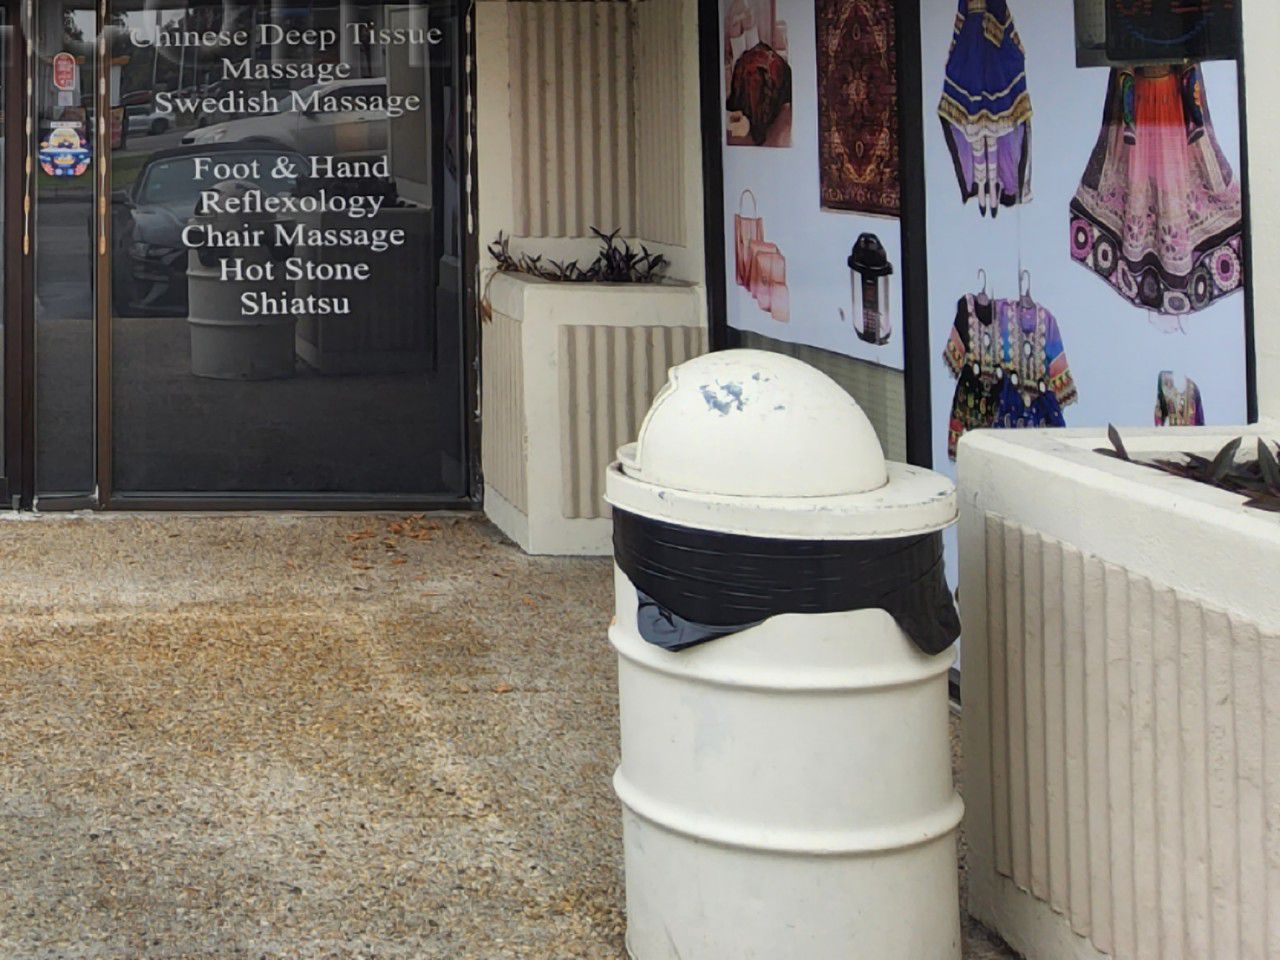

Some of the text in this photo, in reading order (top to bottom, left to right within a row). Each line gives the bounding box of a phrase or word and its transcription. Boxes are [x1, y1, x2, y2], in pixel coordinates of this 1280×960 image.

[129, 21, 442, 51] Chinese Deep Tissue
[221, 57, 351, 84] Massage
[154, 90, 420, 117] Swedish Massage
[192, 155, 391, 181] Foot & Hand
[199, 189, 385, 218] Reflexology
[181, 223, 406, 252] Chair Massage
[219, 257, 371, 282] Hot Stone
[240, 291, 352, 316] Shiatsu
